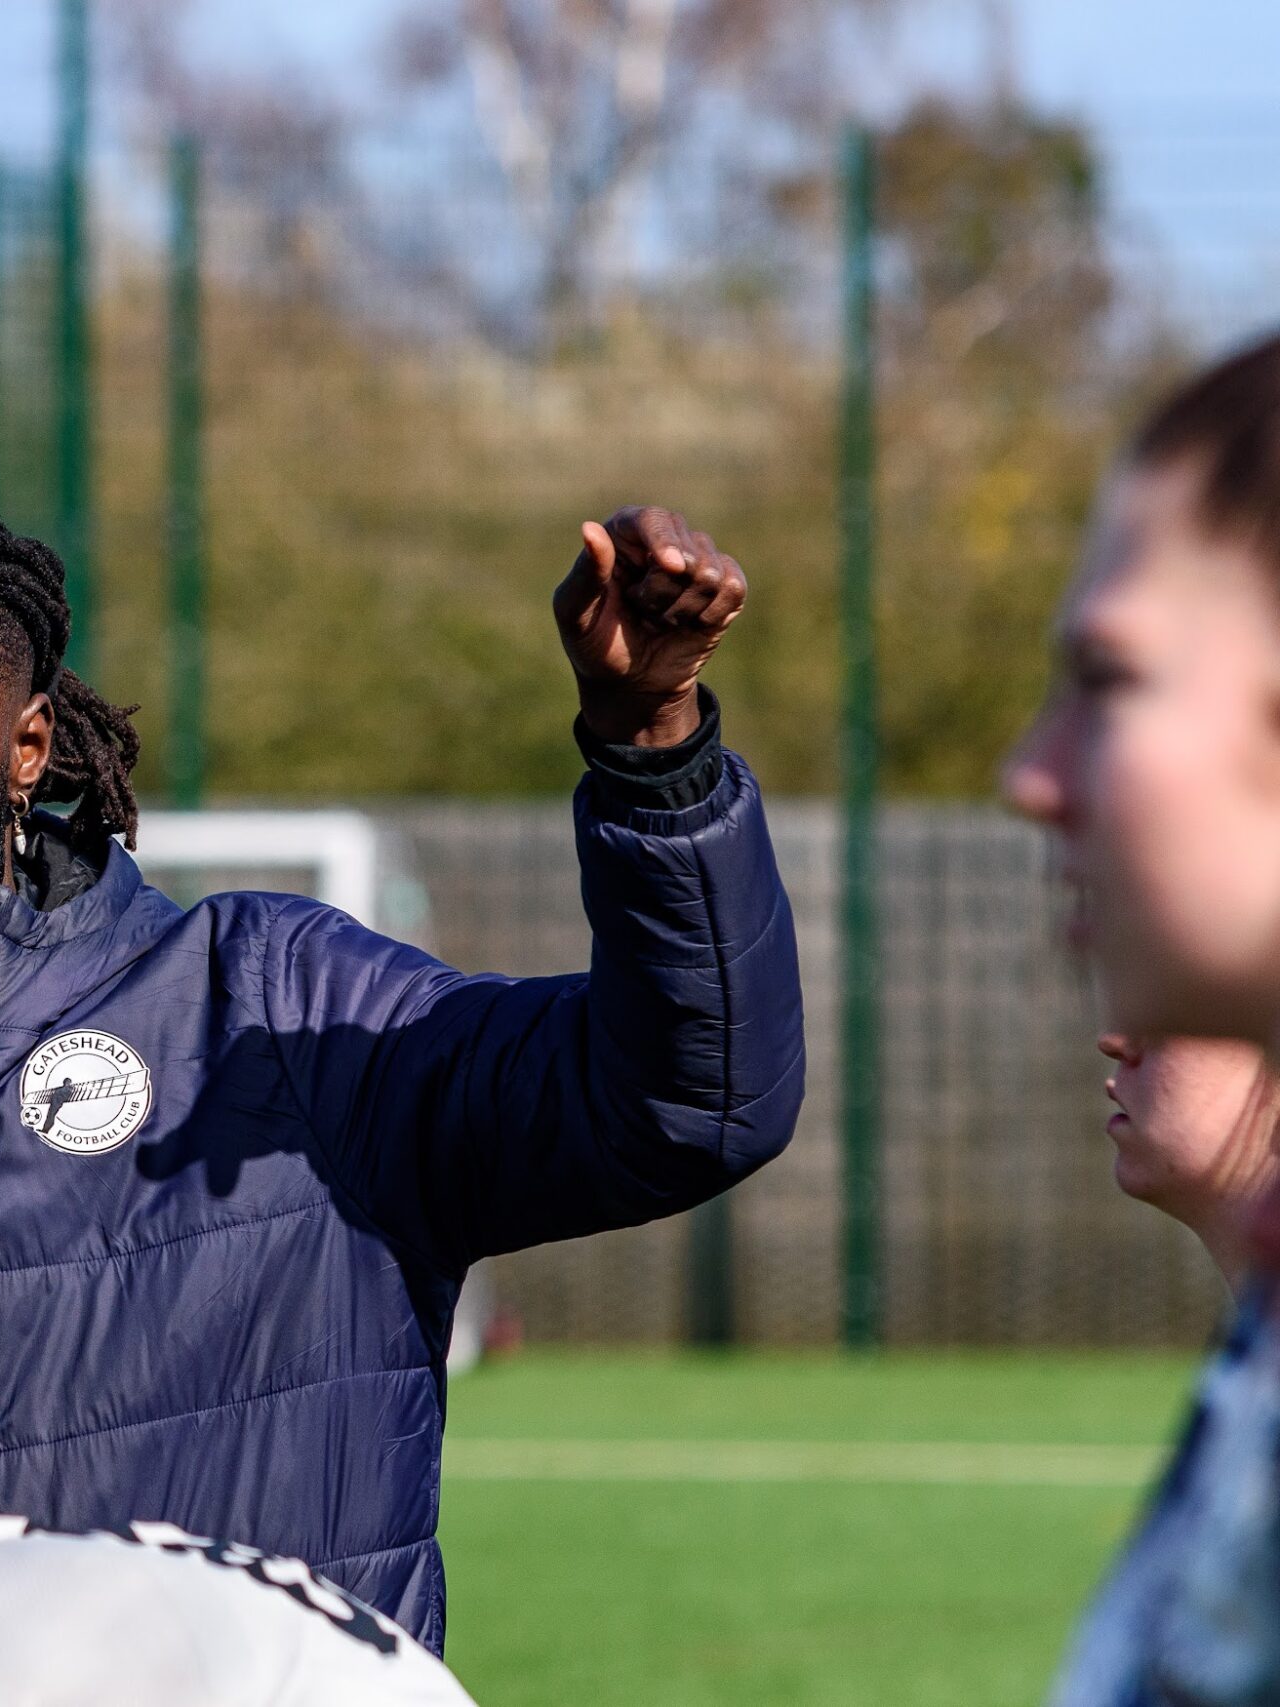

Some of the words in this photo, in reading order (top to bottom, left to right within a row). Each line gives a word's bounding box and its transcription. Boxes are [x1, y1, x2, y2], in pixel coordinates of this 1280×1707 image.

[32, 1036, 129, 1076] GATESHEAD
[56, 1129, 120, 1145] FOOTBALL
[120, 1101, 140, 1129] CLUB
